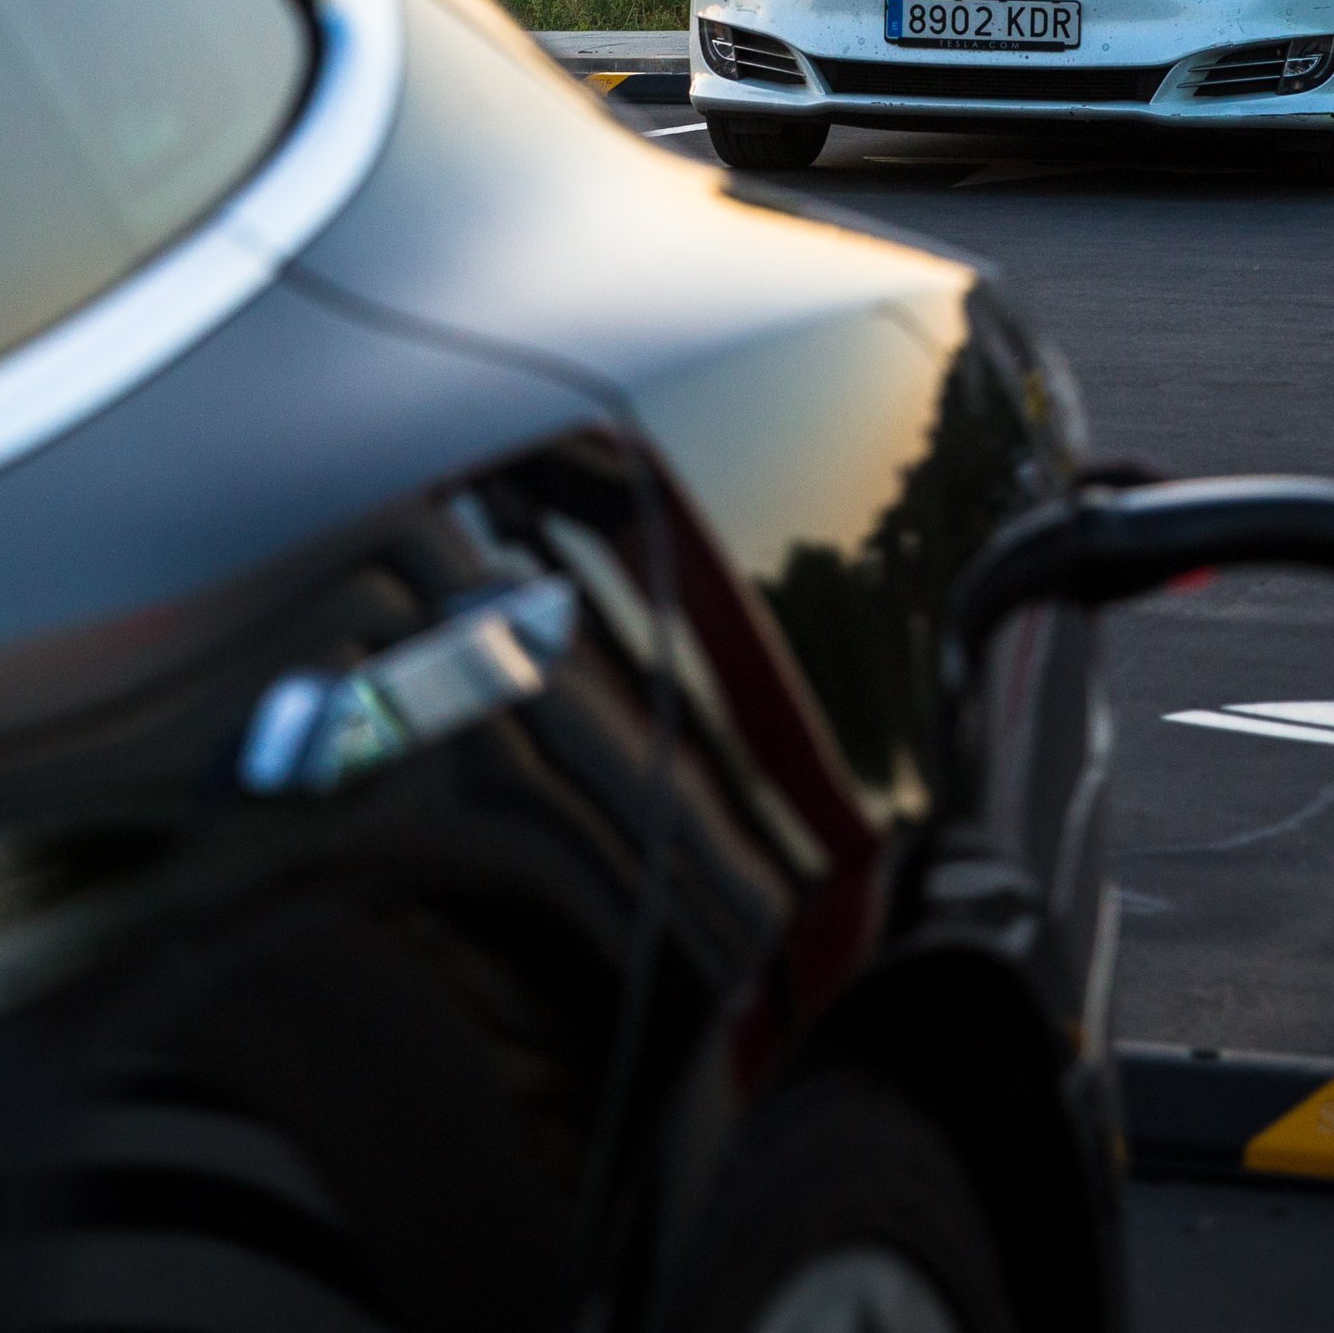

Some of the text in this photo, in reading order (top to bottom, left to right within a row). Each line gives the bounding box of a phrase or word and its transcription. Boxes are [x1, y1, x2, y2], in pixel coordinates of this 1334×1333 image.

[891, 21, 899, 31] E
[908, 4, 1072, 39] 8902 KDR
